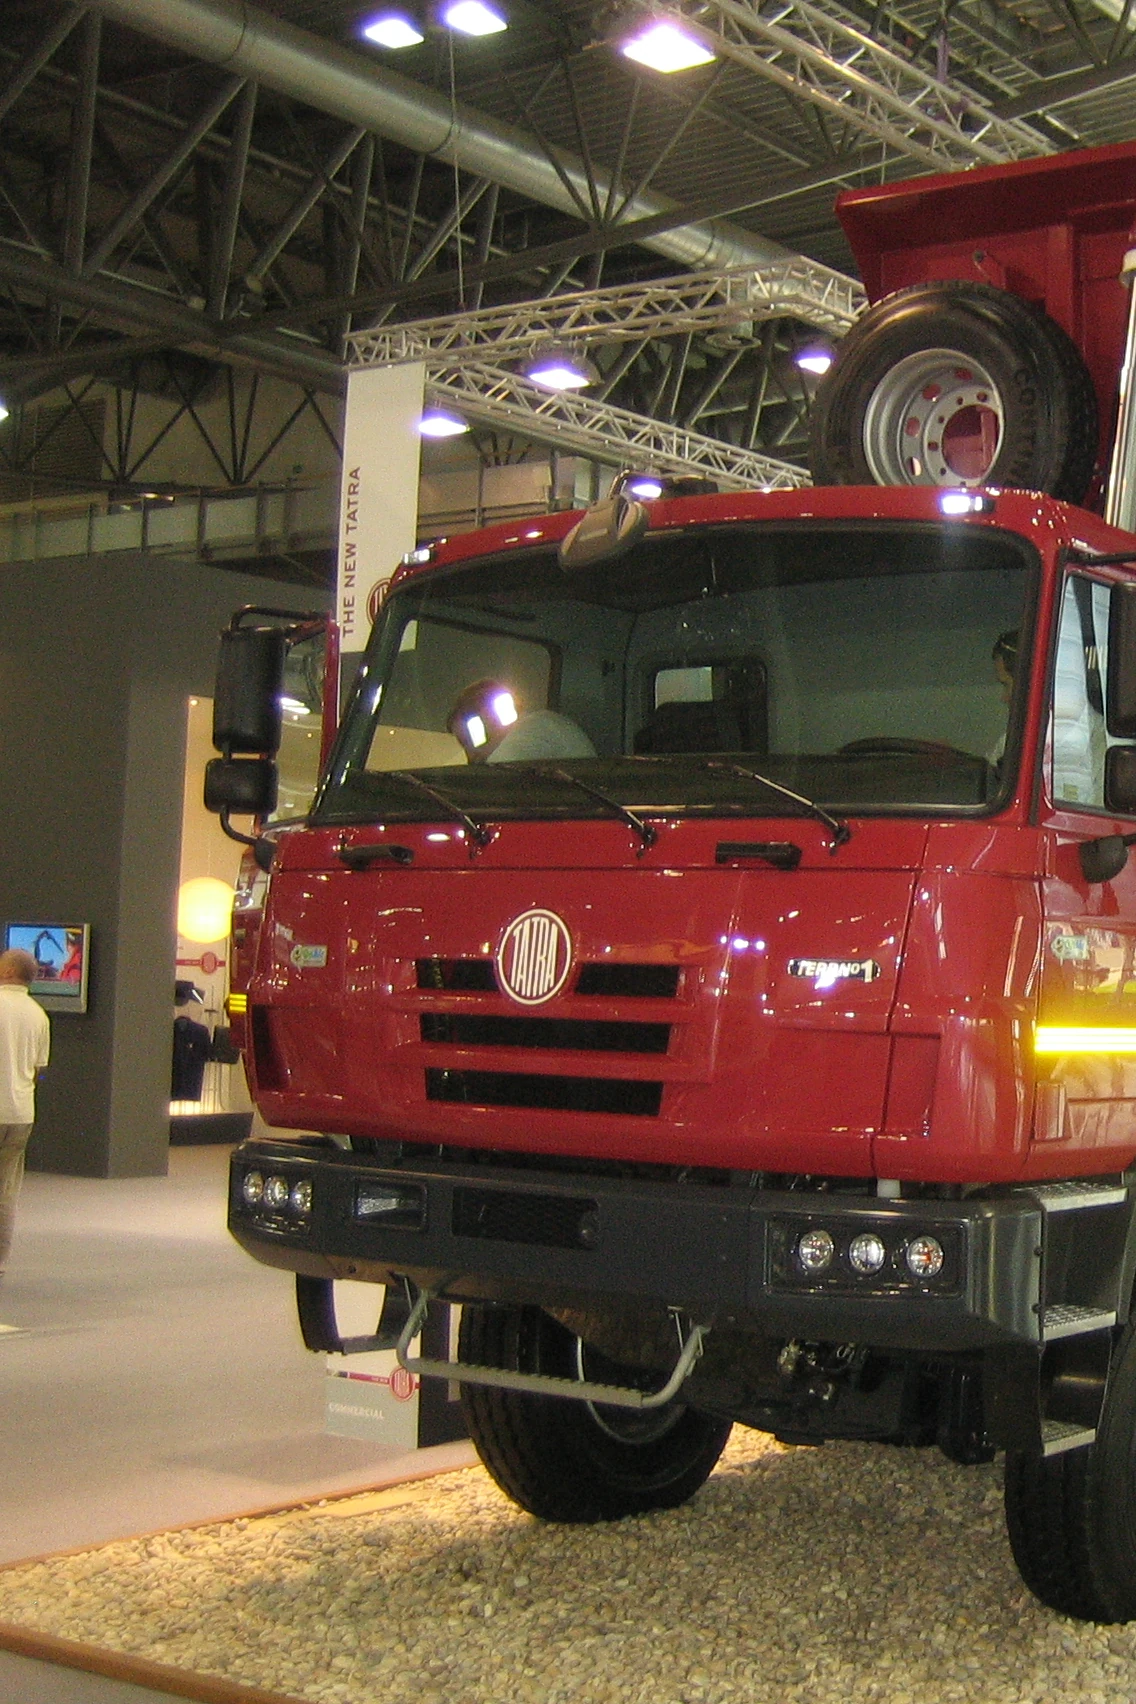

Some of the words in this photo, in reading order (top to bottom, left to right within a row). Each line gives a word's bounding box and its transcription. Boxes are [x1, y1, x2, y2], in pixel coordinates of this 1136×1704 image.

[346, 466, 361, 535] TATRA
[344, 542, 357, 587] NEW
[342, 596, 355, 639] THE
[511, 916, 559, 997] TATRA
